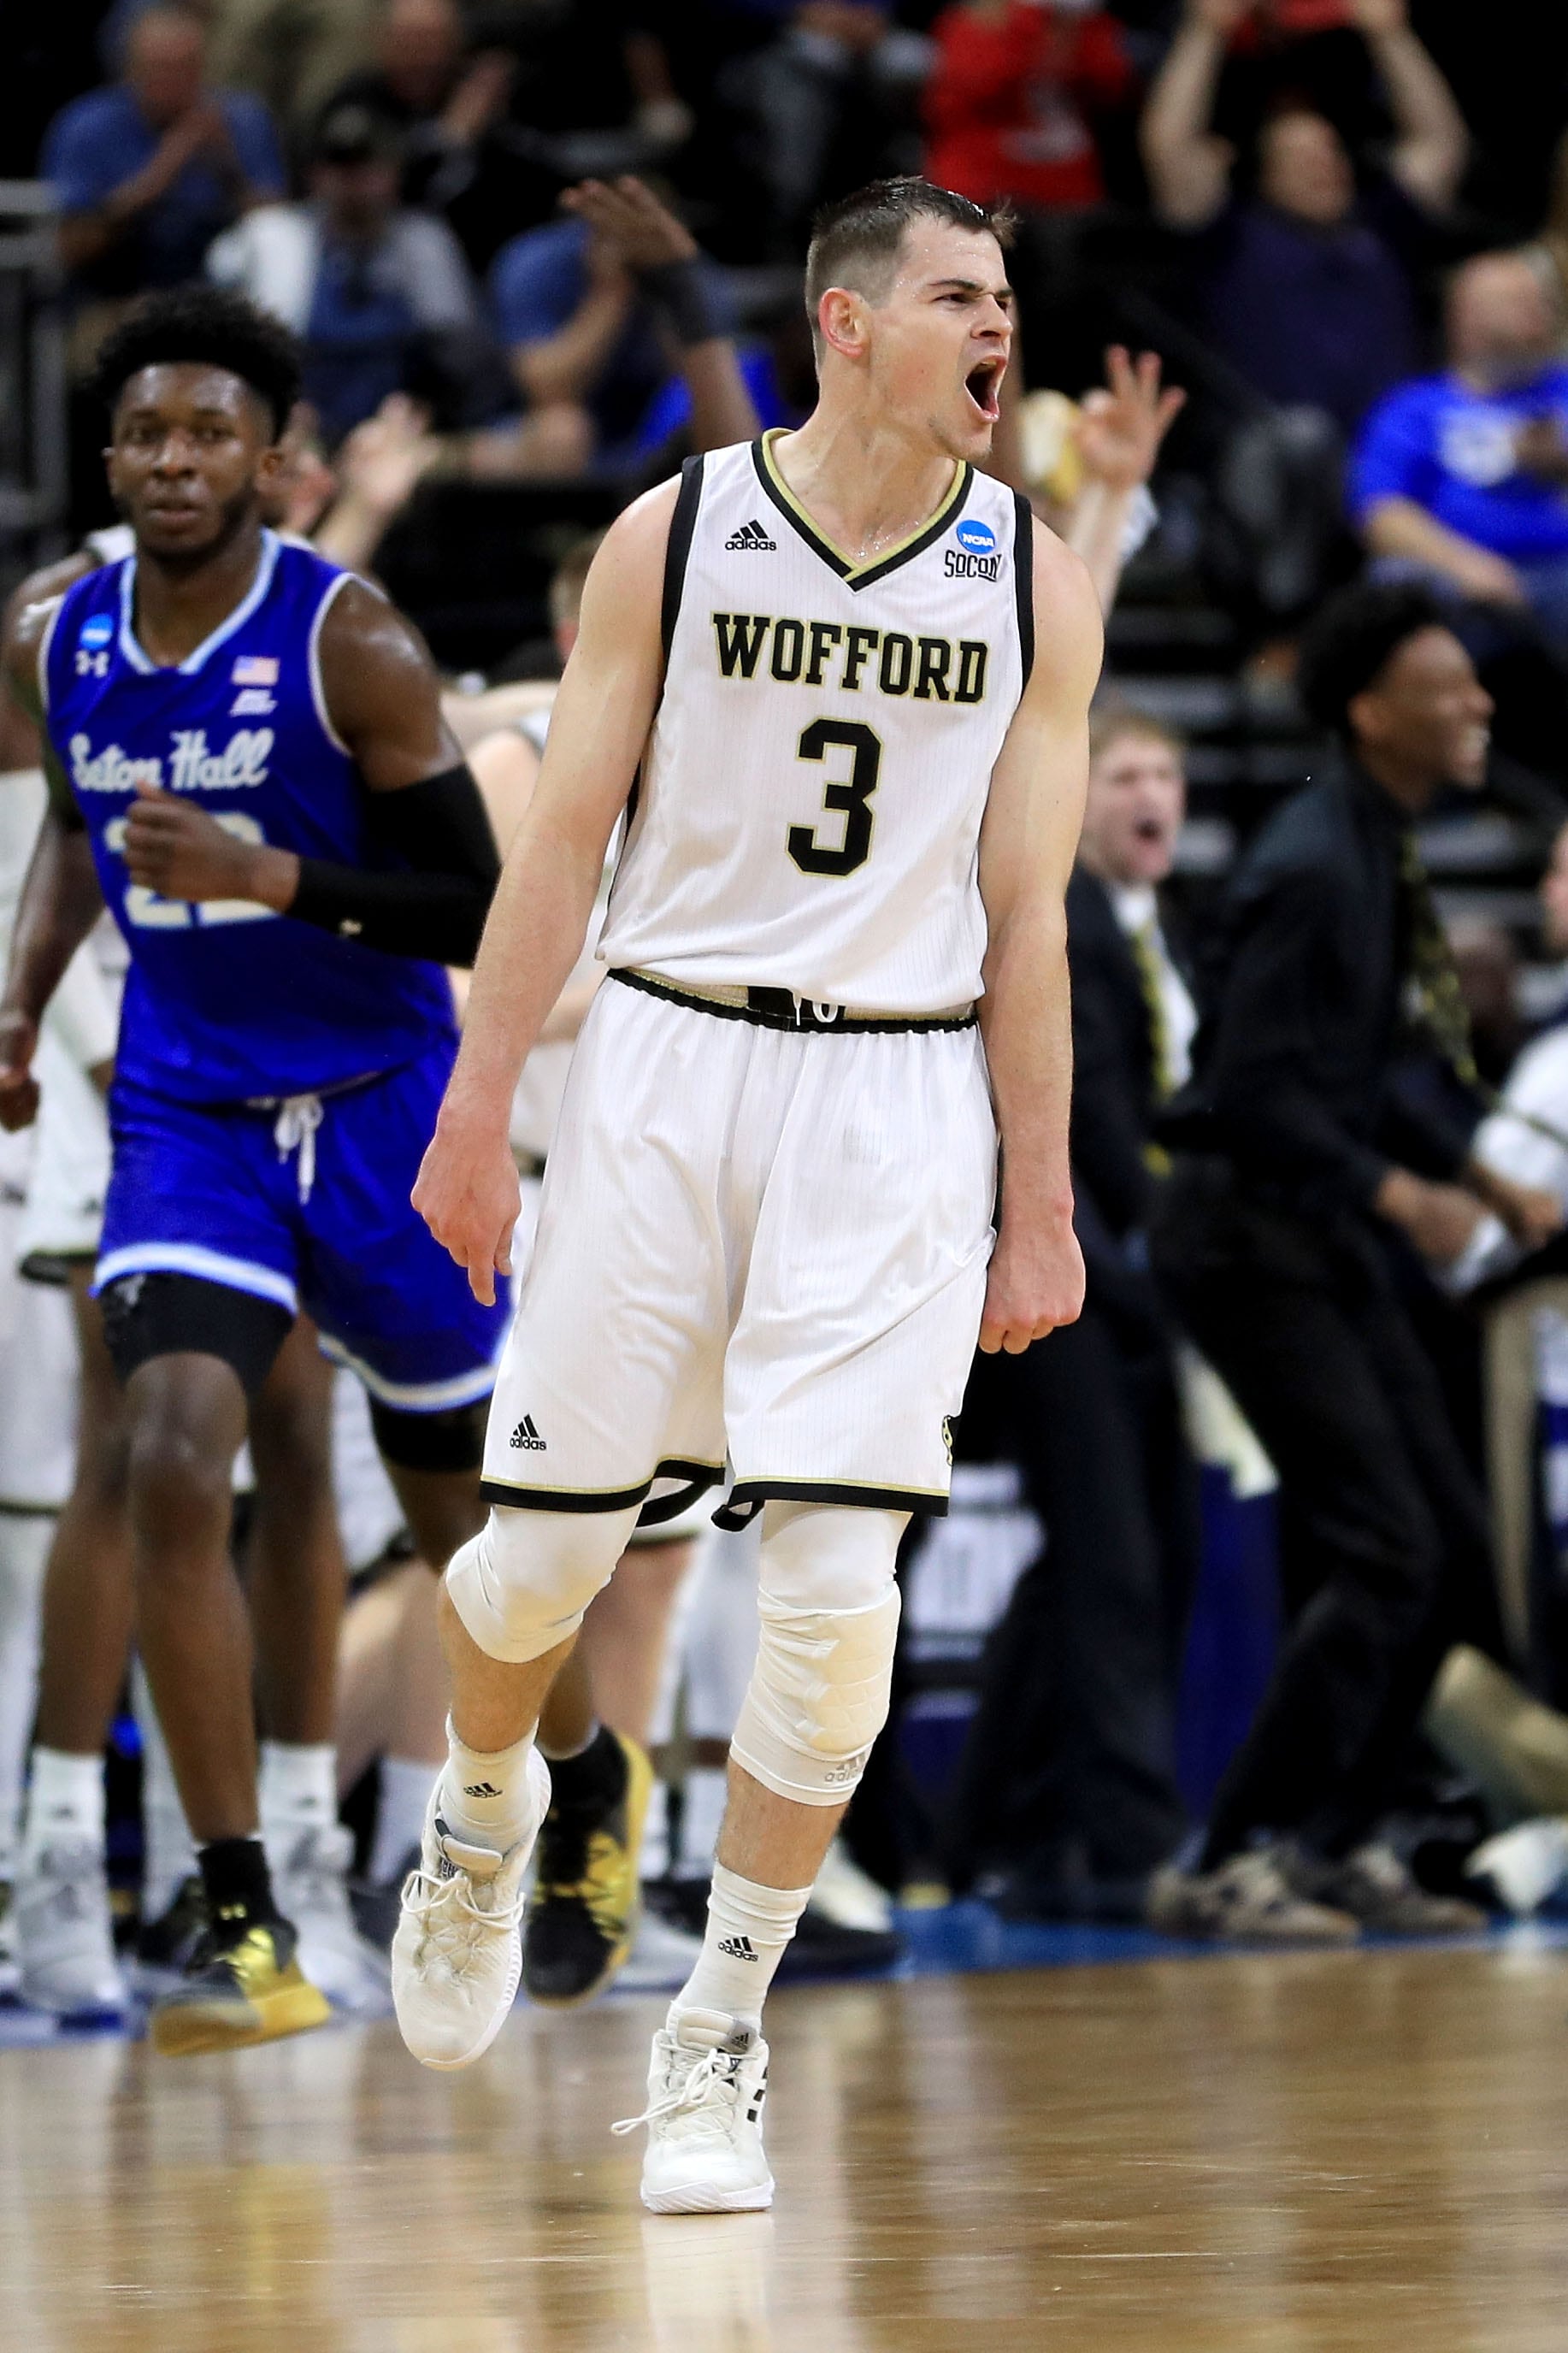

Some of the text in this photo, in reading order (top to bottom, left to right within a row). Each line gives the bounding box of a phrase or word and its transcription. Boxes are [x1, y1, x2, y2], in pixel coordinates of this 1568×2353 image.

[724, 537, 777, 551] adidas
[962, 533, 994, 547] NCAA
[711, 610, 990, 705] WOFFORD
[168, 727, 275, 790] Hall
[786, 716, 884, 880] 3
[510, 1436, 547, 1451] adidas
[717, 1942, 758, 1962] adidas
